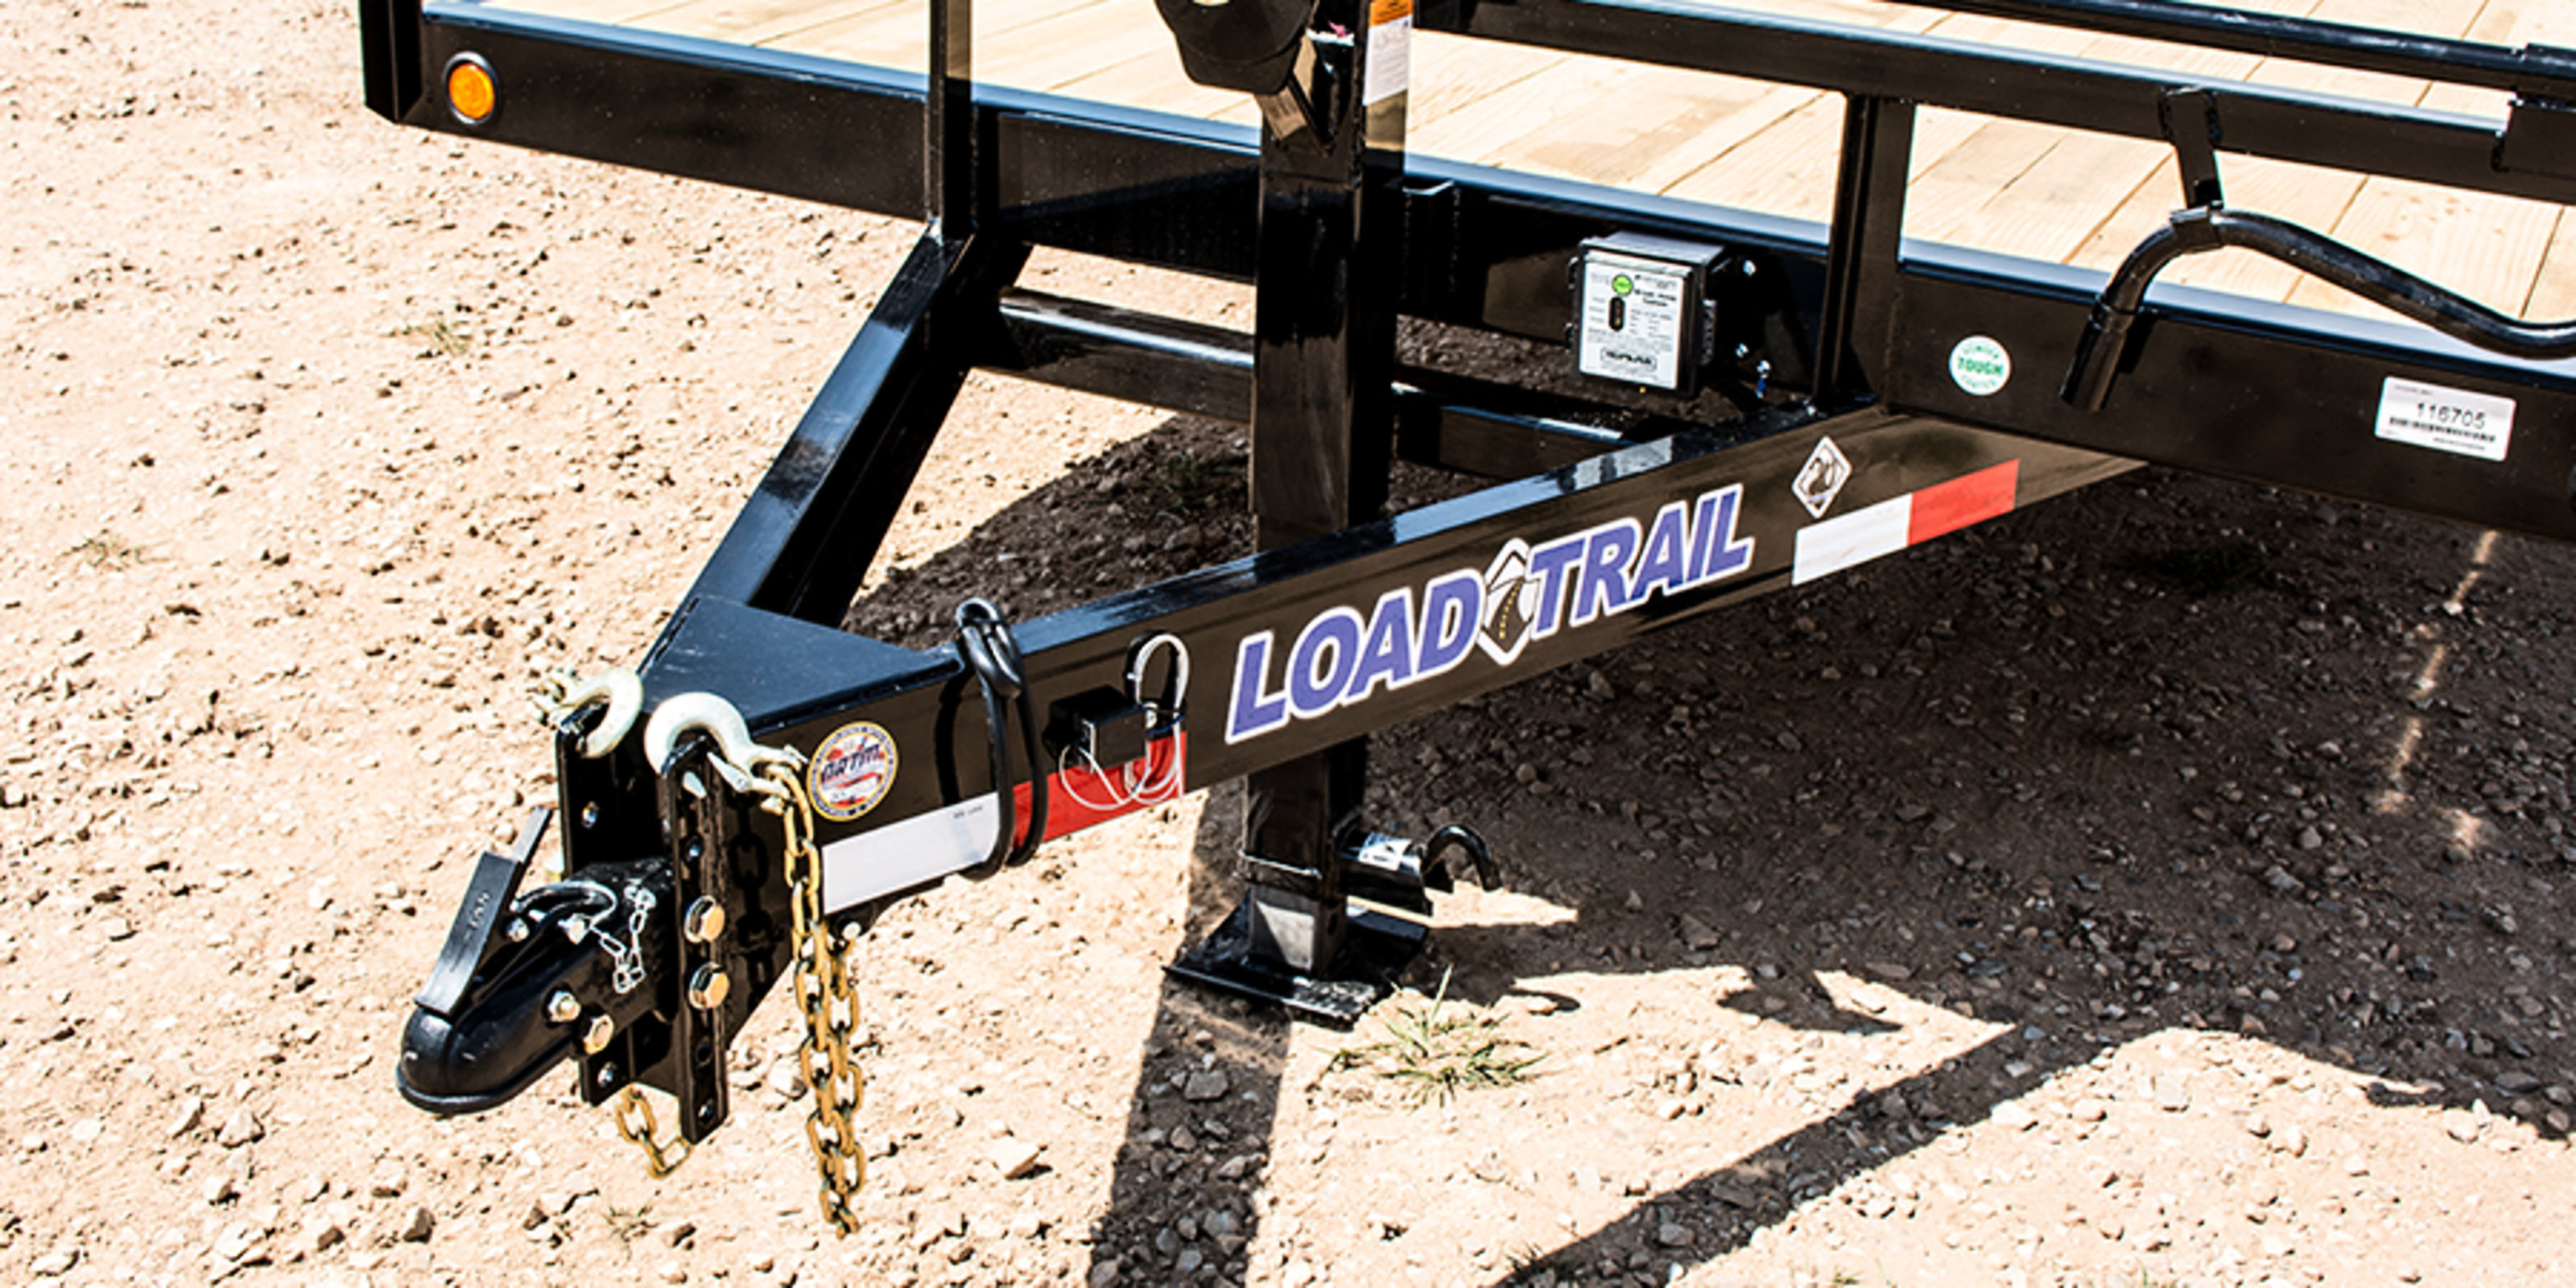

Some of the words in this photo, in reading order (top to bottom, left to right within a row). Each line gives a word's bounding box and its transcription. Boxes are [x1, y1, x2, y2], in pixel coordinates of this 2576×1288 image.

[2417, 402, 2487, 430] 116705
[1227, 570, 1485, 742] LOAD
[1528, 485, 1753, 640] TRAIL
